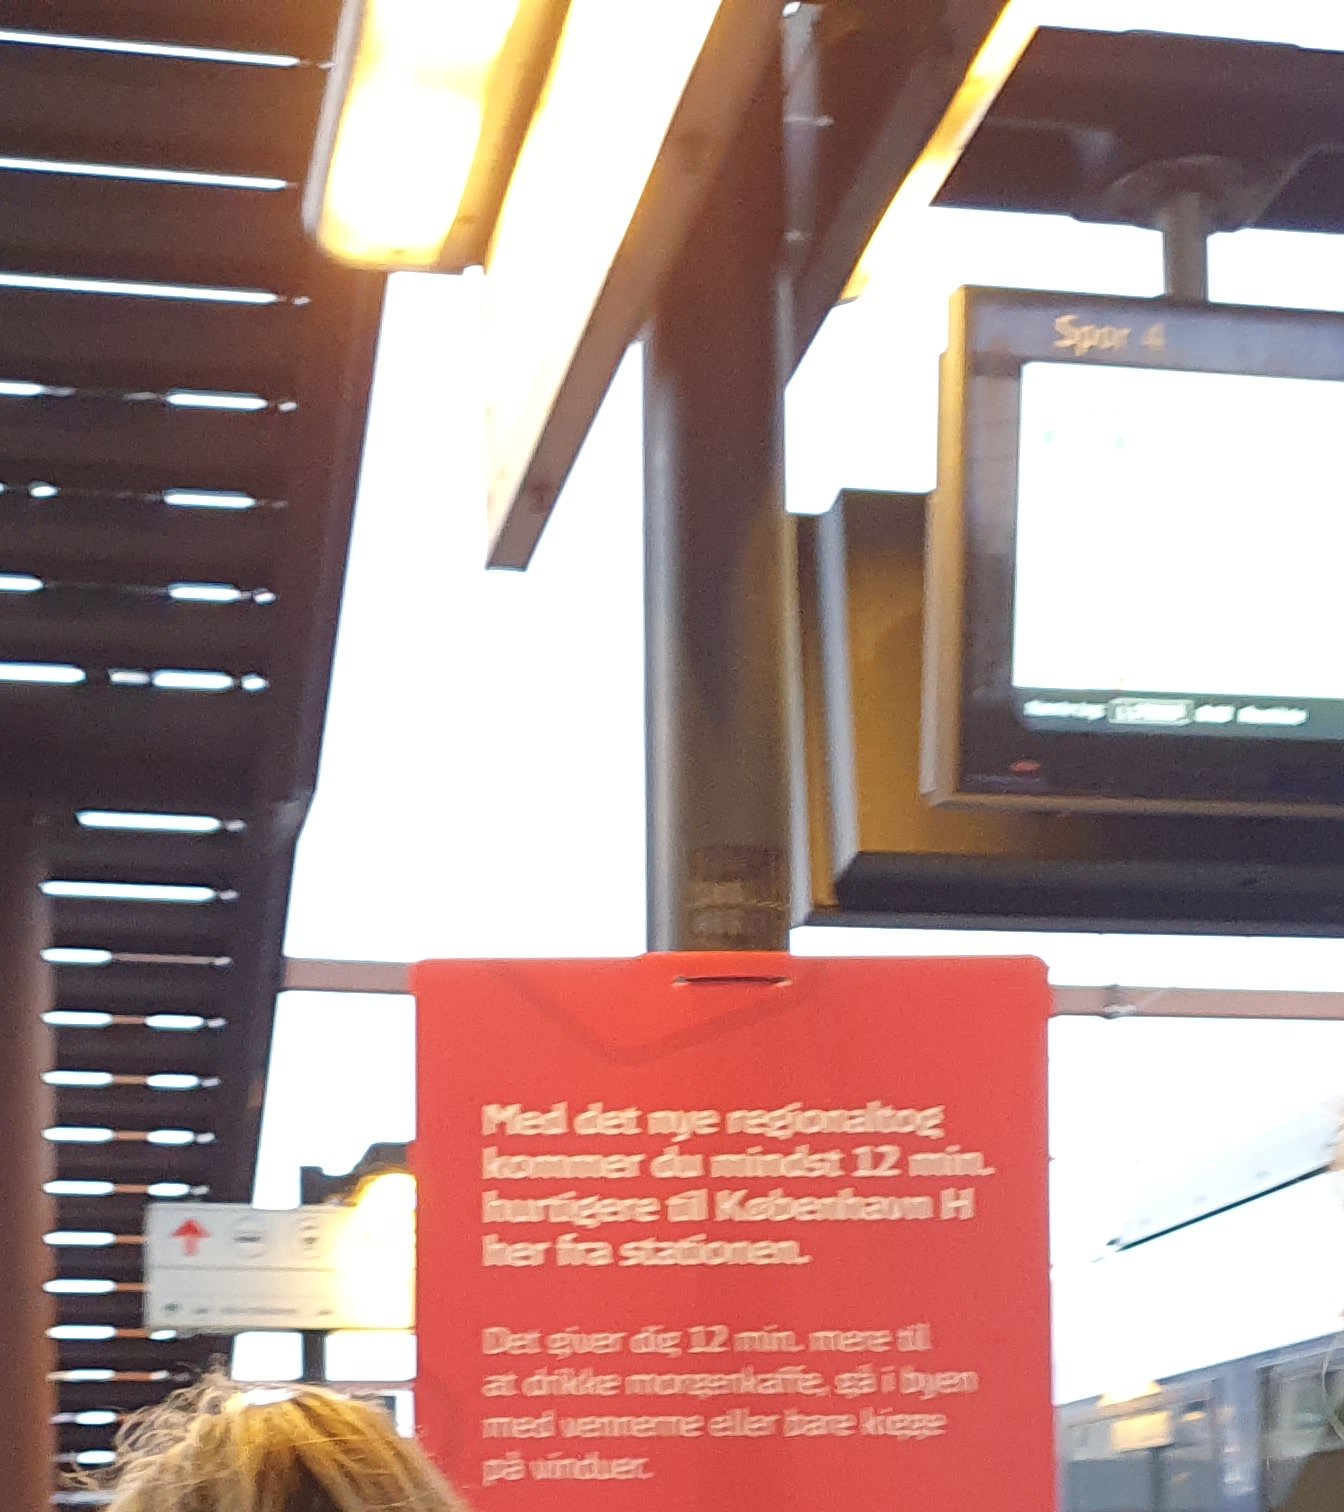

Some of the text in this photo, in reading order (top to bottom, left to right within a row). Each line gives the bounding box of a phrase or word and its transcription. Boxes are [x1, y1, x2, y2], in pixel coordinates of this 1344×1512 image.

[1054, 314, 1131, 356] Spor
[481, 1100, 946, 1142] Med det nye regionaltog
[482, 1144, 996, 1179] kommer du mindst 12 min.
[482, 1187, 975, 1228] hurtigere til København H
[482, 1232, 813, 1266] her fra stationen.
[482, 1323, 932, 1360] Det giver dig 12 min. mere til
[482, 1363, 980, 1400] at drikke morgenkaffe, gå i byen
[482, 1407, 948, 1440] med vennerne eller bare kigge
[482, 1451, 654, 1487] på vinduer.
